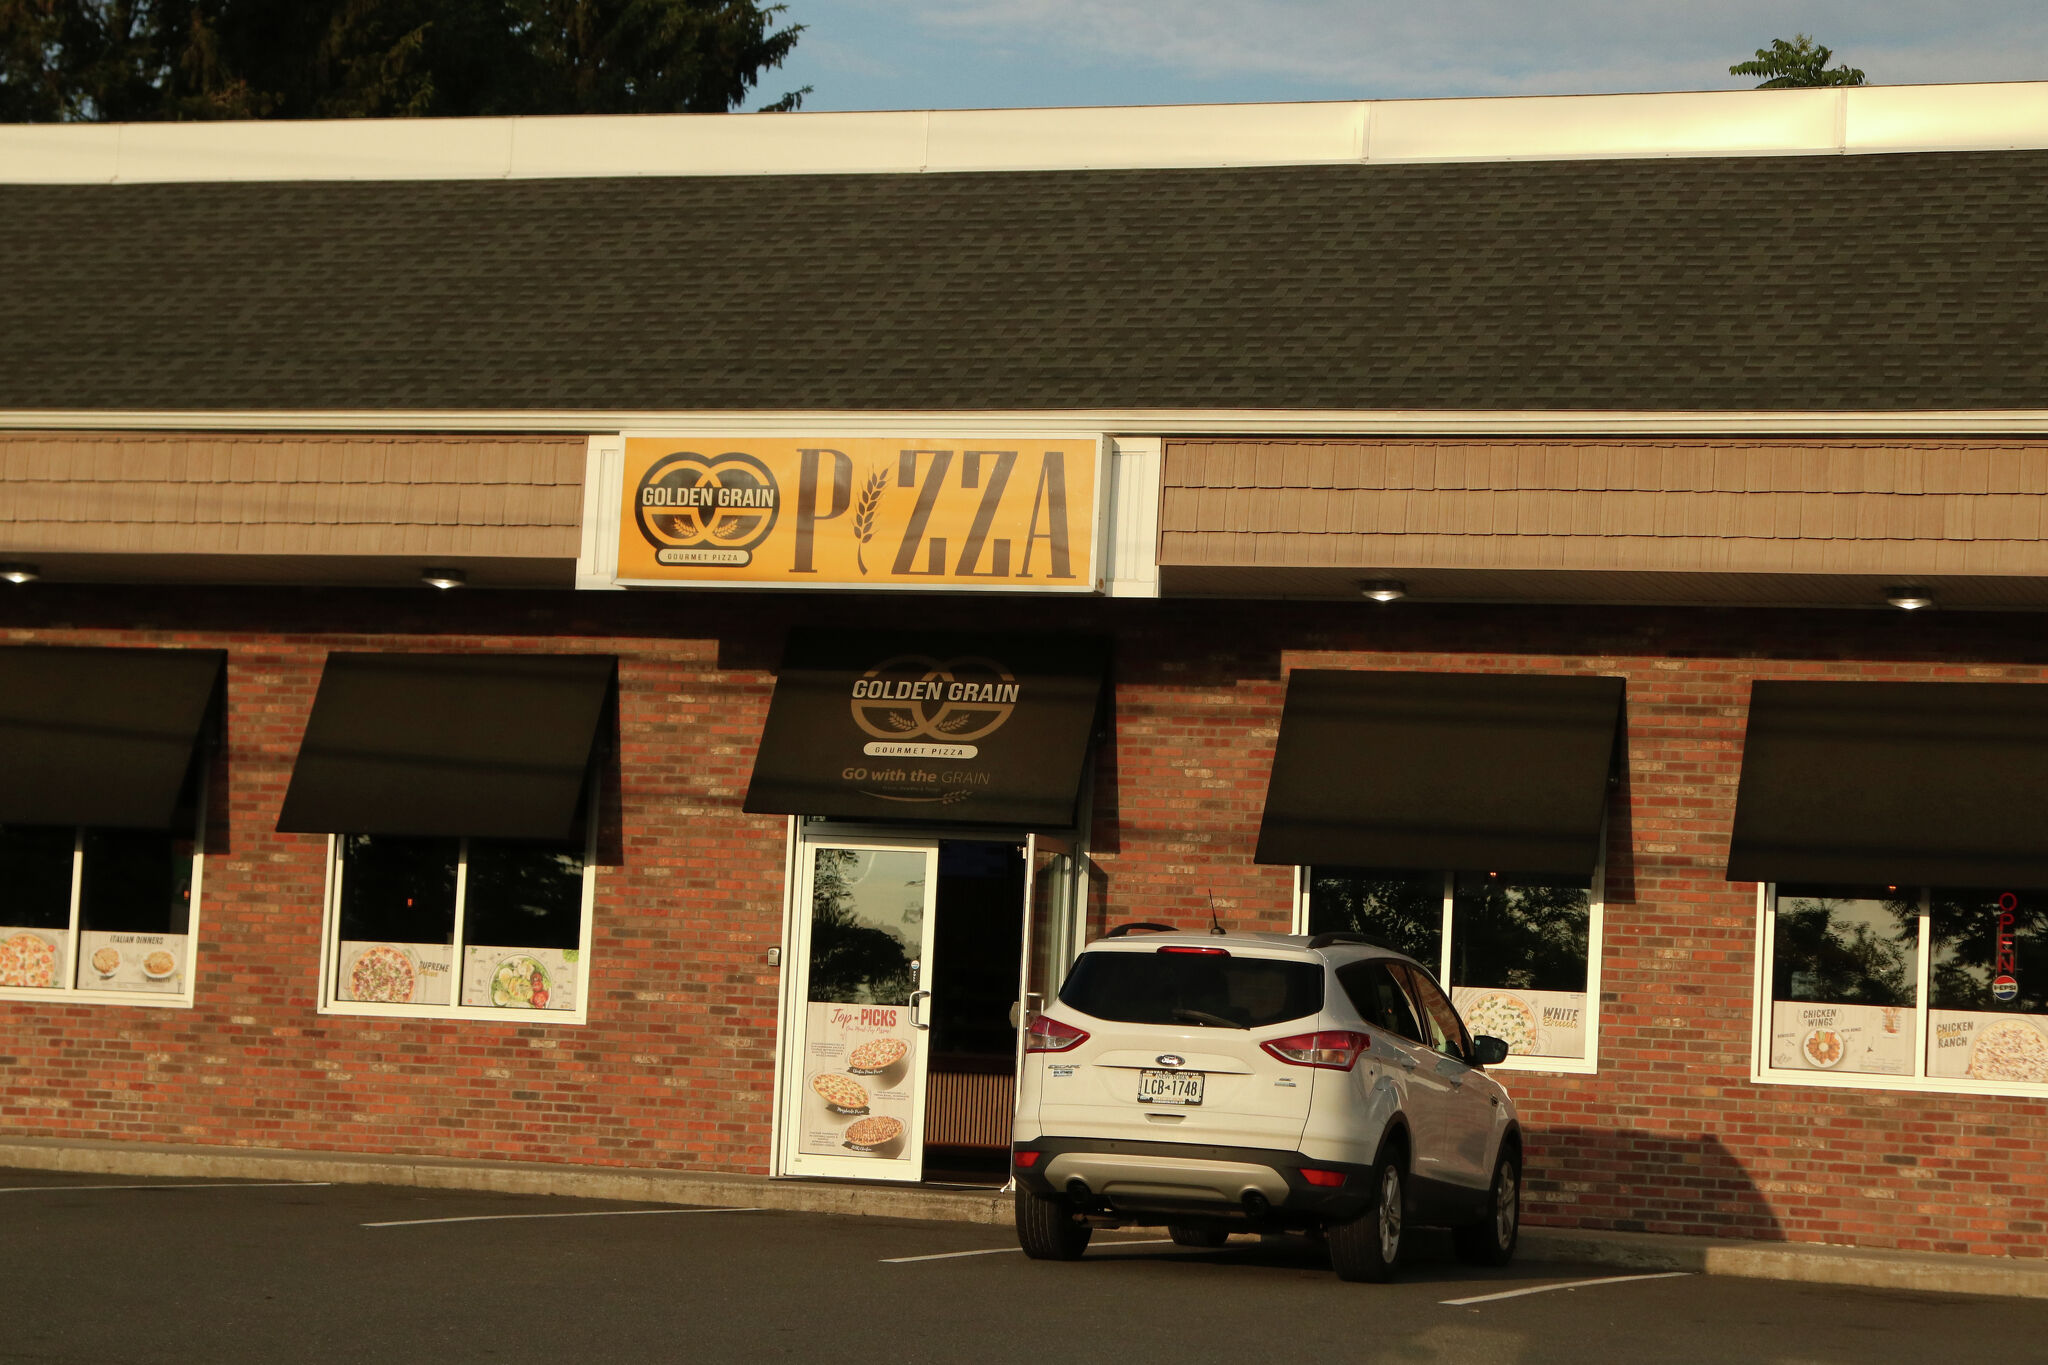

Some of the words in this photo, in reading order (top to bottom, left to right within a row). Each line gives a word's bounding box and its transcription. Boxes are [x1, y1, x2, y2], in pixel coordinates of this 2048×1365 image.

[641, 486, 714, 507] GOLDEN
[717, 487, 775, 508] GRAIN
[667, 552, 709, 561] GOURMET
[712, 553, 739, 562] PIZZA
[852, 680, 946, 701] GOLDEN
[947, 682, 1020, 703] GRAIN
[874, 746, 926, 756] GOURMET
[931, 747, 964, 756] PIZZA
[841, 767, 868, 781] GO
[871, 768, 906, 781] with
[910, 769, 937, 782] the
[941, 770, 991, 785] GRAIN
[1998, 892, 2018, 974] OPEN
[109, 934, 135, 944] ITALIAN
[136, 936, 164, 945] DINNERS
[830, 1008, 853, 1029] Top
[860, 1008, 897, 1027] PICKS
[1543, 1006, 1579, 1021] WHITE
[1803, 1008, 1837, 1019] CHICKEN
[1807, 1017, 1834, 1027] WINGS
[1936, 1021, 1974, 1033] CHICKEN
[1938, 1036, 1968, 1048] RANCH
